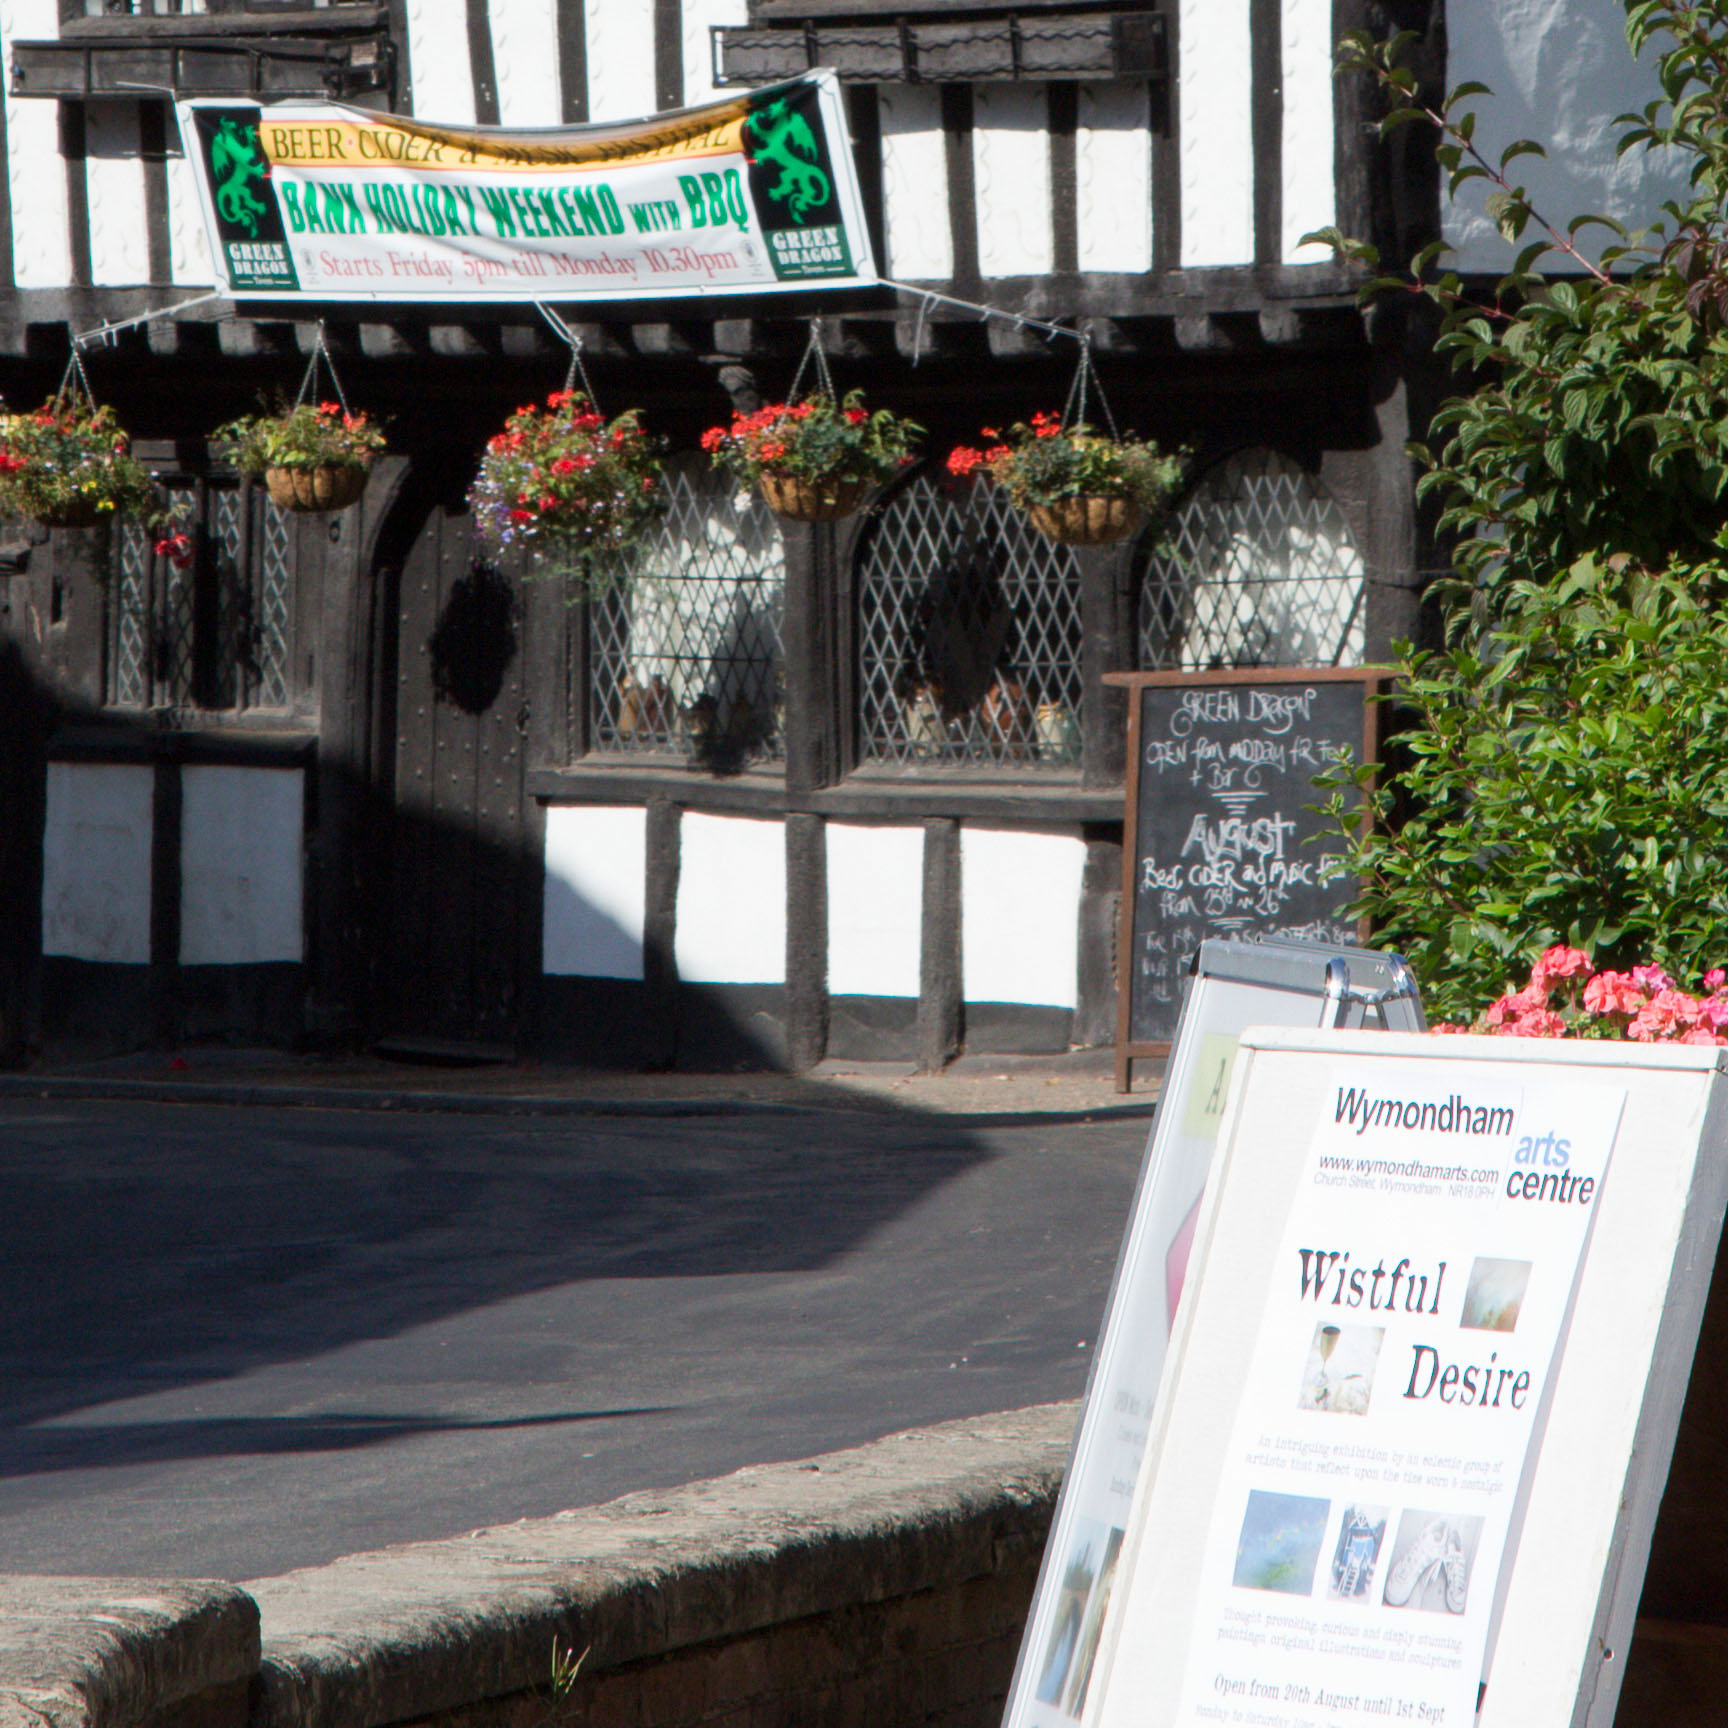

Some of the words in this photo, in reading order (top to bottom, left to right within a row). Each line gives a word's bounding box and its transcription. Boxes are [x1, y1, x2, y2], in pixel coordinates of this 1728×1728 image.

[270, 128, 348, 160] BEER
[358, 129, 445, 163] CIDER
[281, 181, 368, 234] BANK
[363, 182, 483, 237] HOLIDAY
[477, 183, 625, 238] WEEKEND
[627, 200, 682, 234] WITH
[675, 168, 750, 234] BBQ
[229, 243, 285, 260] GREEN
[772, 226, 839, 250] GREEN
[777, 245, 843, 265] DRAGON
[232, 261, 289, 275] DRAGON
[320, 250, 382, 278] Starts
[385, 251, 453, 285] Friday
[462, 251, 508, 285] 5pm
[512, 245, 548, 277] till
[551, 251, 638, 281] Monday
[639, 246, 739, 278] 10.30pm
[1334, 1086, 1515, 1137] Wymondham
[1514, 1130, 1572, 1167] arts
[1319, 1154, 1500, 1184] www.wymondhamarts.com
[1380, 1177, 1442, 1196] Wymondham
[1505, 1167, 1596, 1205] centre
[1298, 1247, 1447, 1316] Wistful
[1403, 1344, 1531, 1411] Desire
[1214, 1672, 1246, 1697] Open
[1249, 1677, 1280, 1700] from
[1284, 1683, 1311, 1705] 20th
[1314, 1688, 1361, 1712] August
[1363, 1695, 1392, 1717] until
[1396, 1699, 1414, 1720] 1st
[1417, 1701, 1446, 1726] Sept
